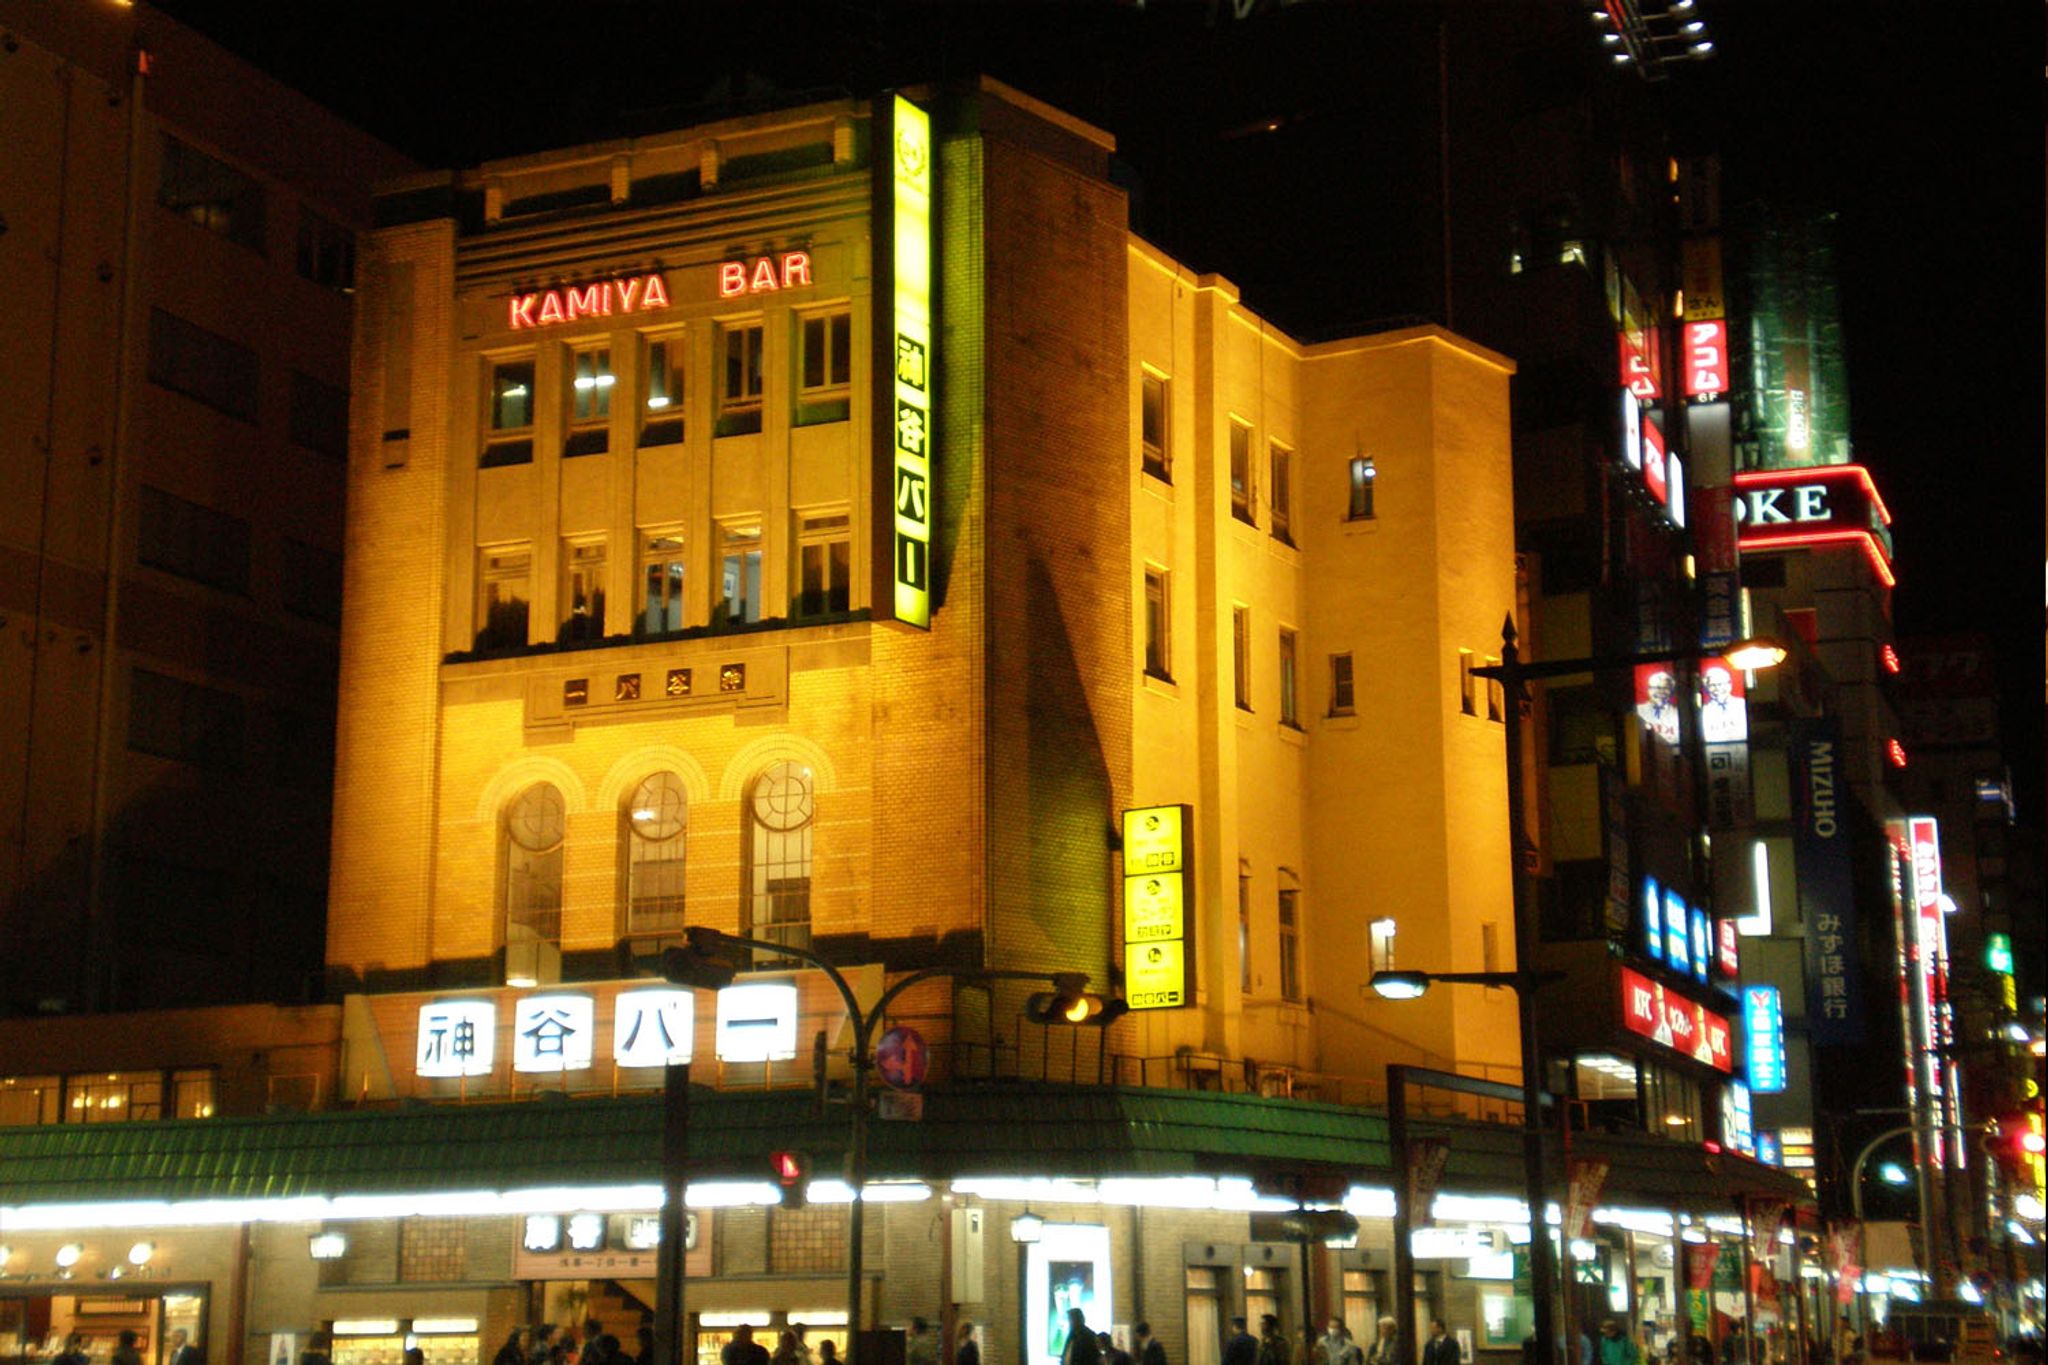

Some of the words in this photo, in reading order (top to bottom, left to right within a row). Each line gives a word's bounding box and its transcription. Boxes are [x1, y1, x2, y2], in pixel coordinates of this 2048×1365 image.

[509, 274, 669, 330] KAMIYA
[719, 252, 813, 299] BAR
[1692, 322, 1721, 391] アコム
[898, 339, 925, 584] 神谷バー
[1809, 741, 1837, 839] MIZUHO
[1817, 912, 1848, 1020] みずほ銀行
[424, 1001, 779, 1064] 神谷バー
